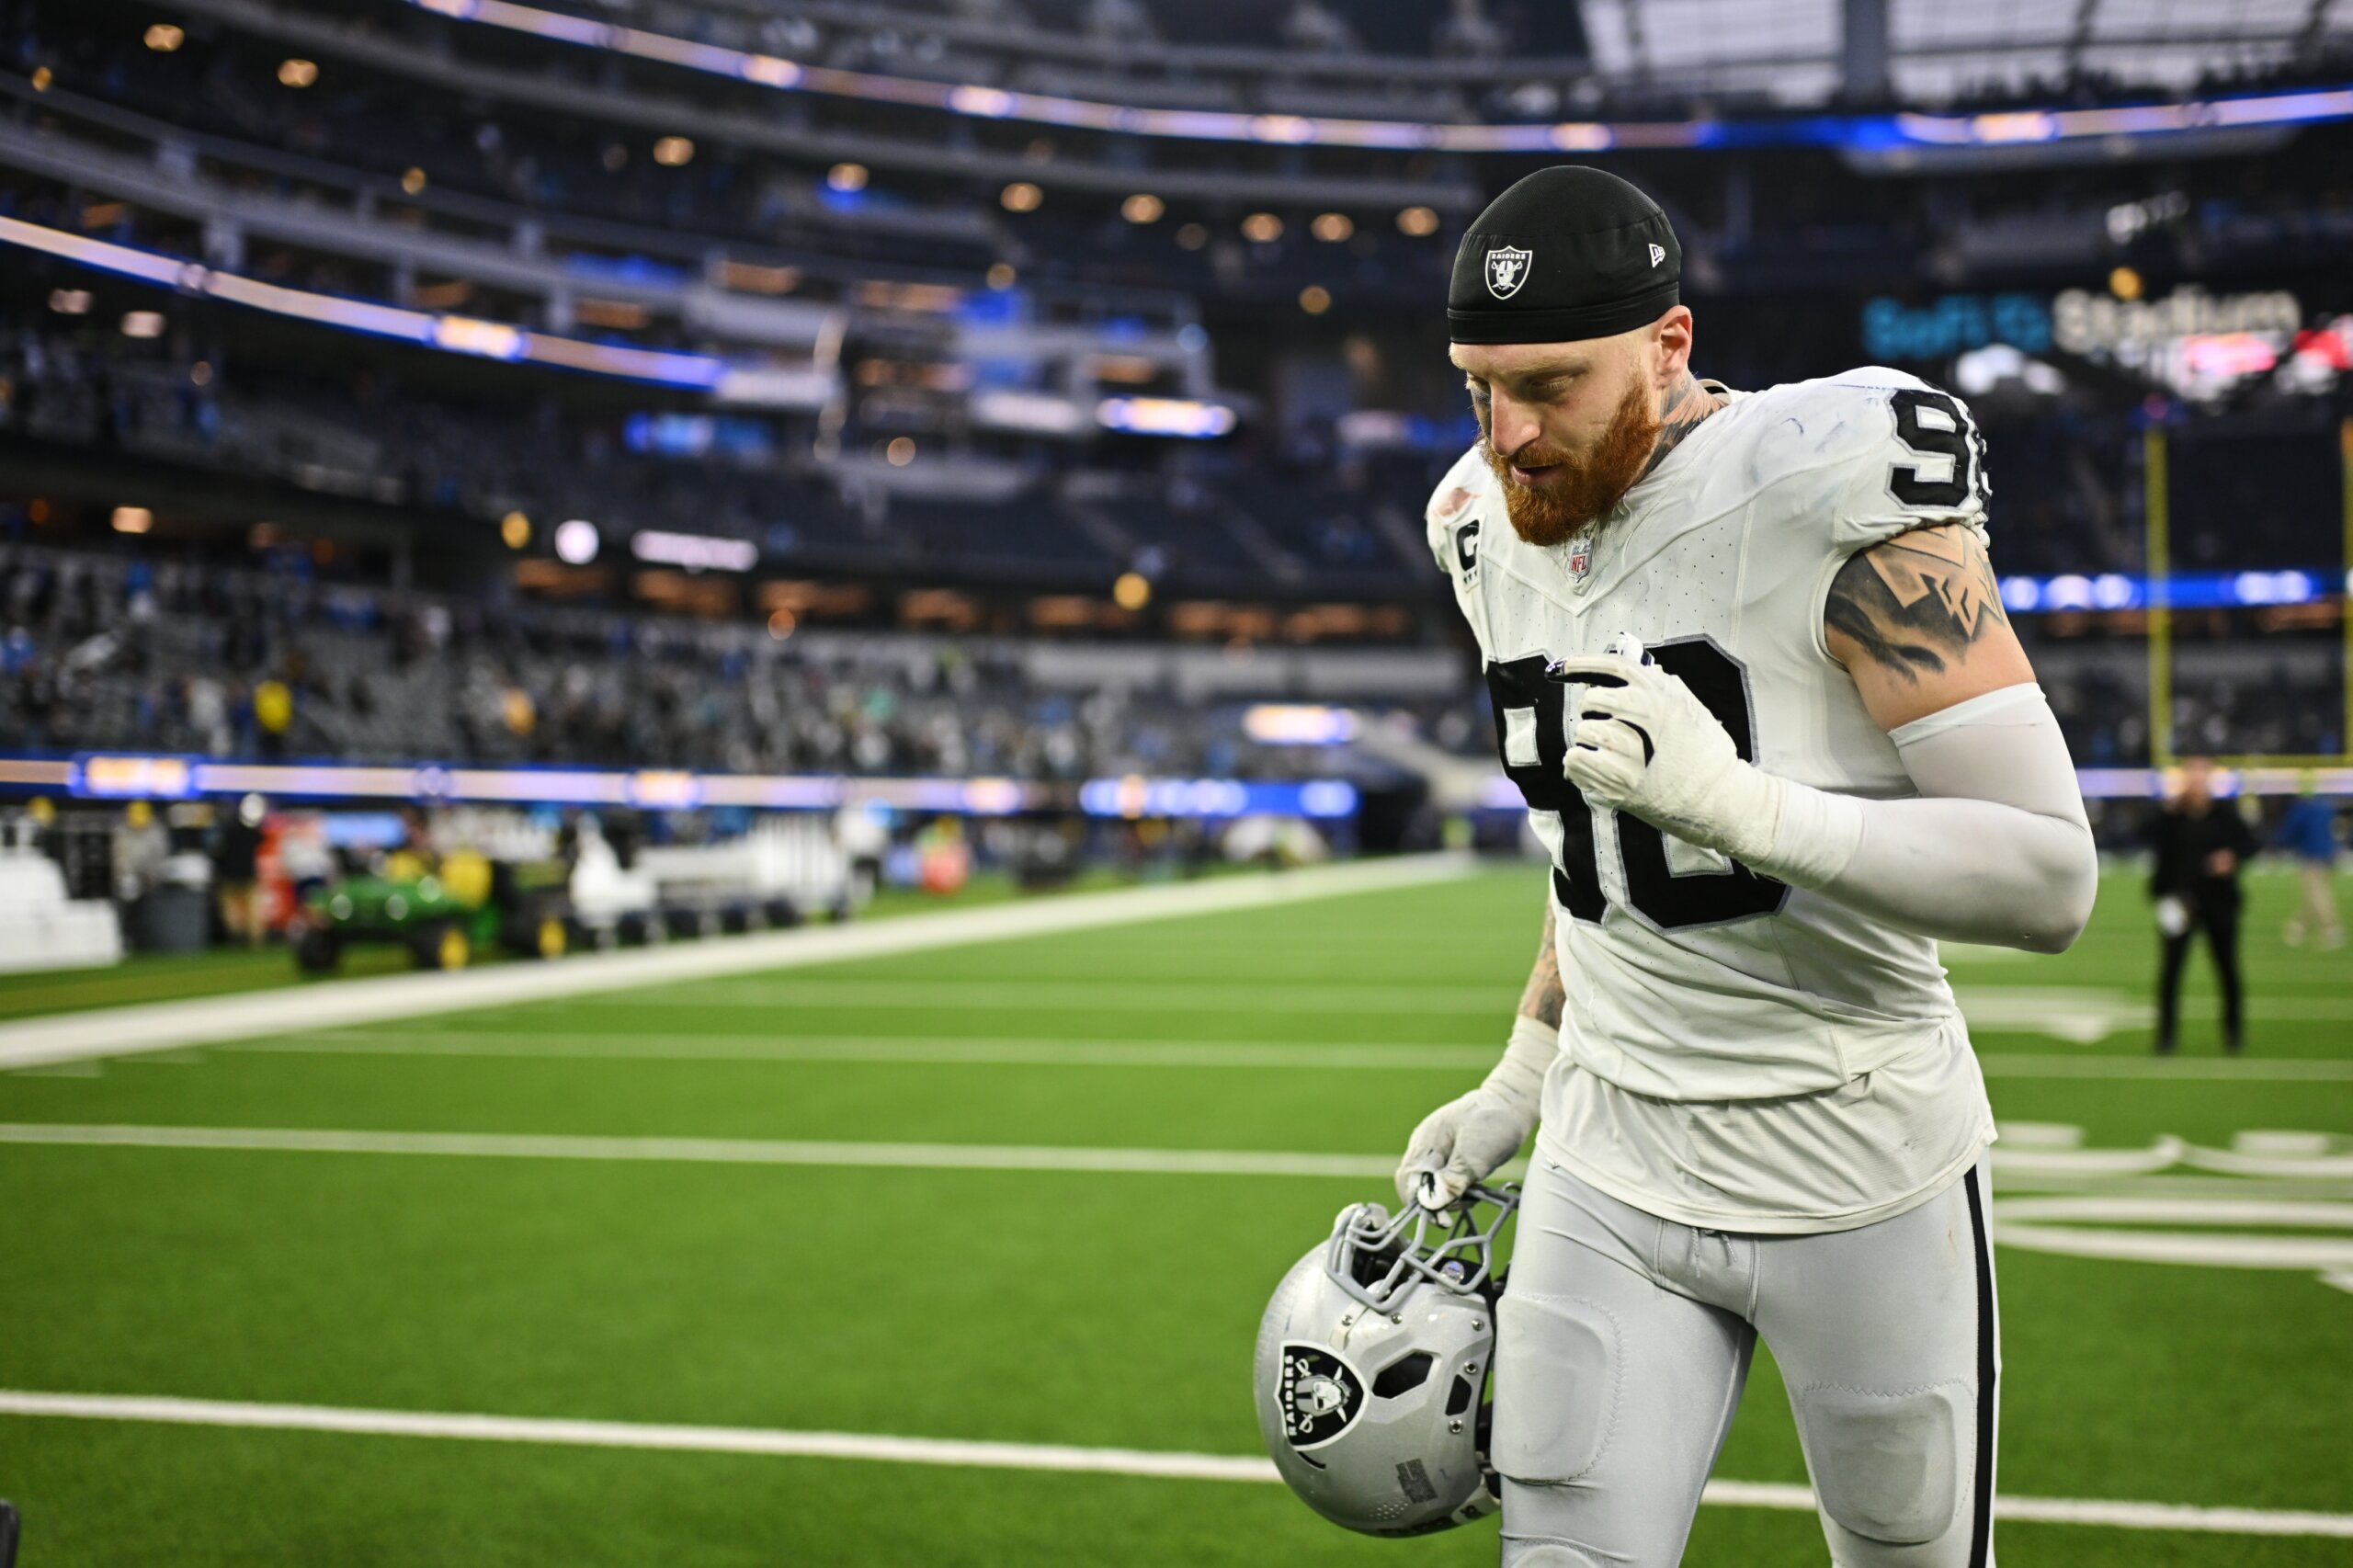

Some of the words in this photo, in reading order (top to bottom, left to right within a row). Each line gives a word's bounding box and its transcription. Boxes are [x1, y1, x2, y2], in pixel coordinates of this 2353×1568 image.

[1456, 518, 1481, 572] C
[1571, 554, 1588, 574] NFL
[1283, 1354, 1298, 1436] RAIDERS
